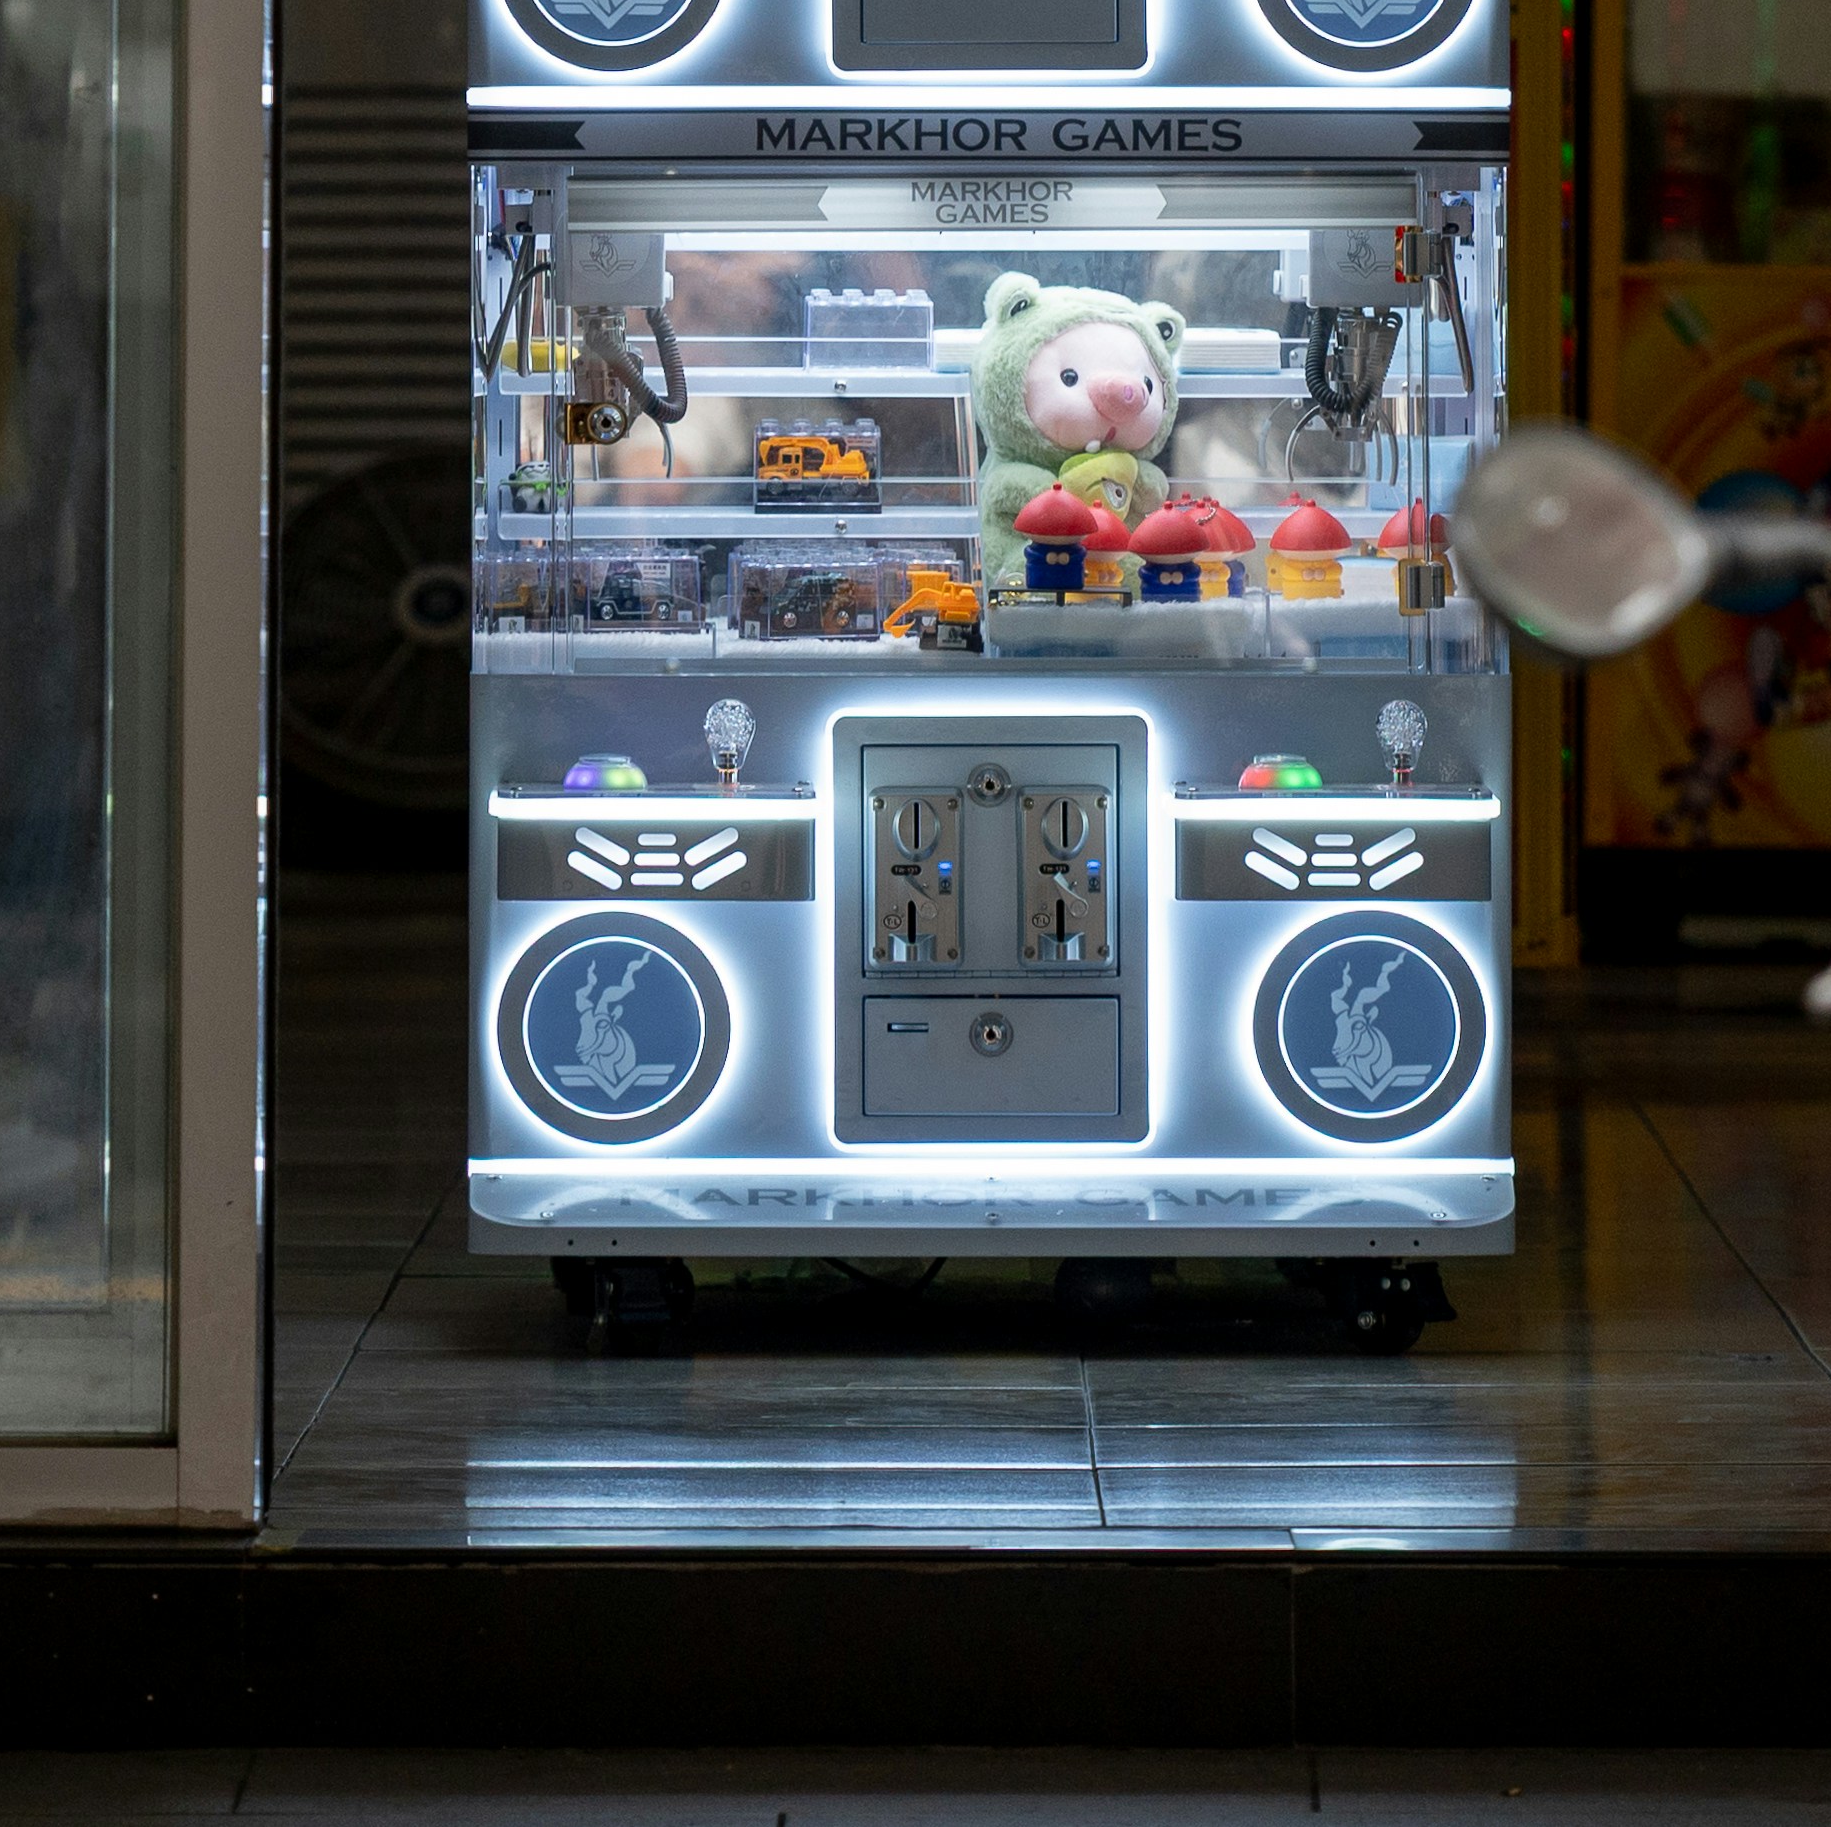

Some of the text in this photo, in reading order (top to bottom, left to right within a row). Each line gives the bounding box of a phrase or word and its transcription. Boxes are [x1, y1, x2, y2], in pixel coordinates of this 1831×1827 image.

[755, 117, 1243, 152] MARKHOR GAMES
[910, 181, 1074, 202] MARKHOR
[935, 203, 1050, 224] GAMES
